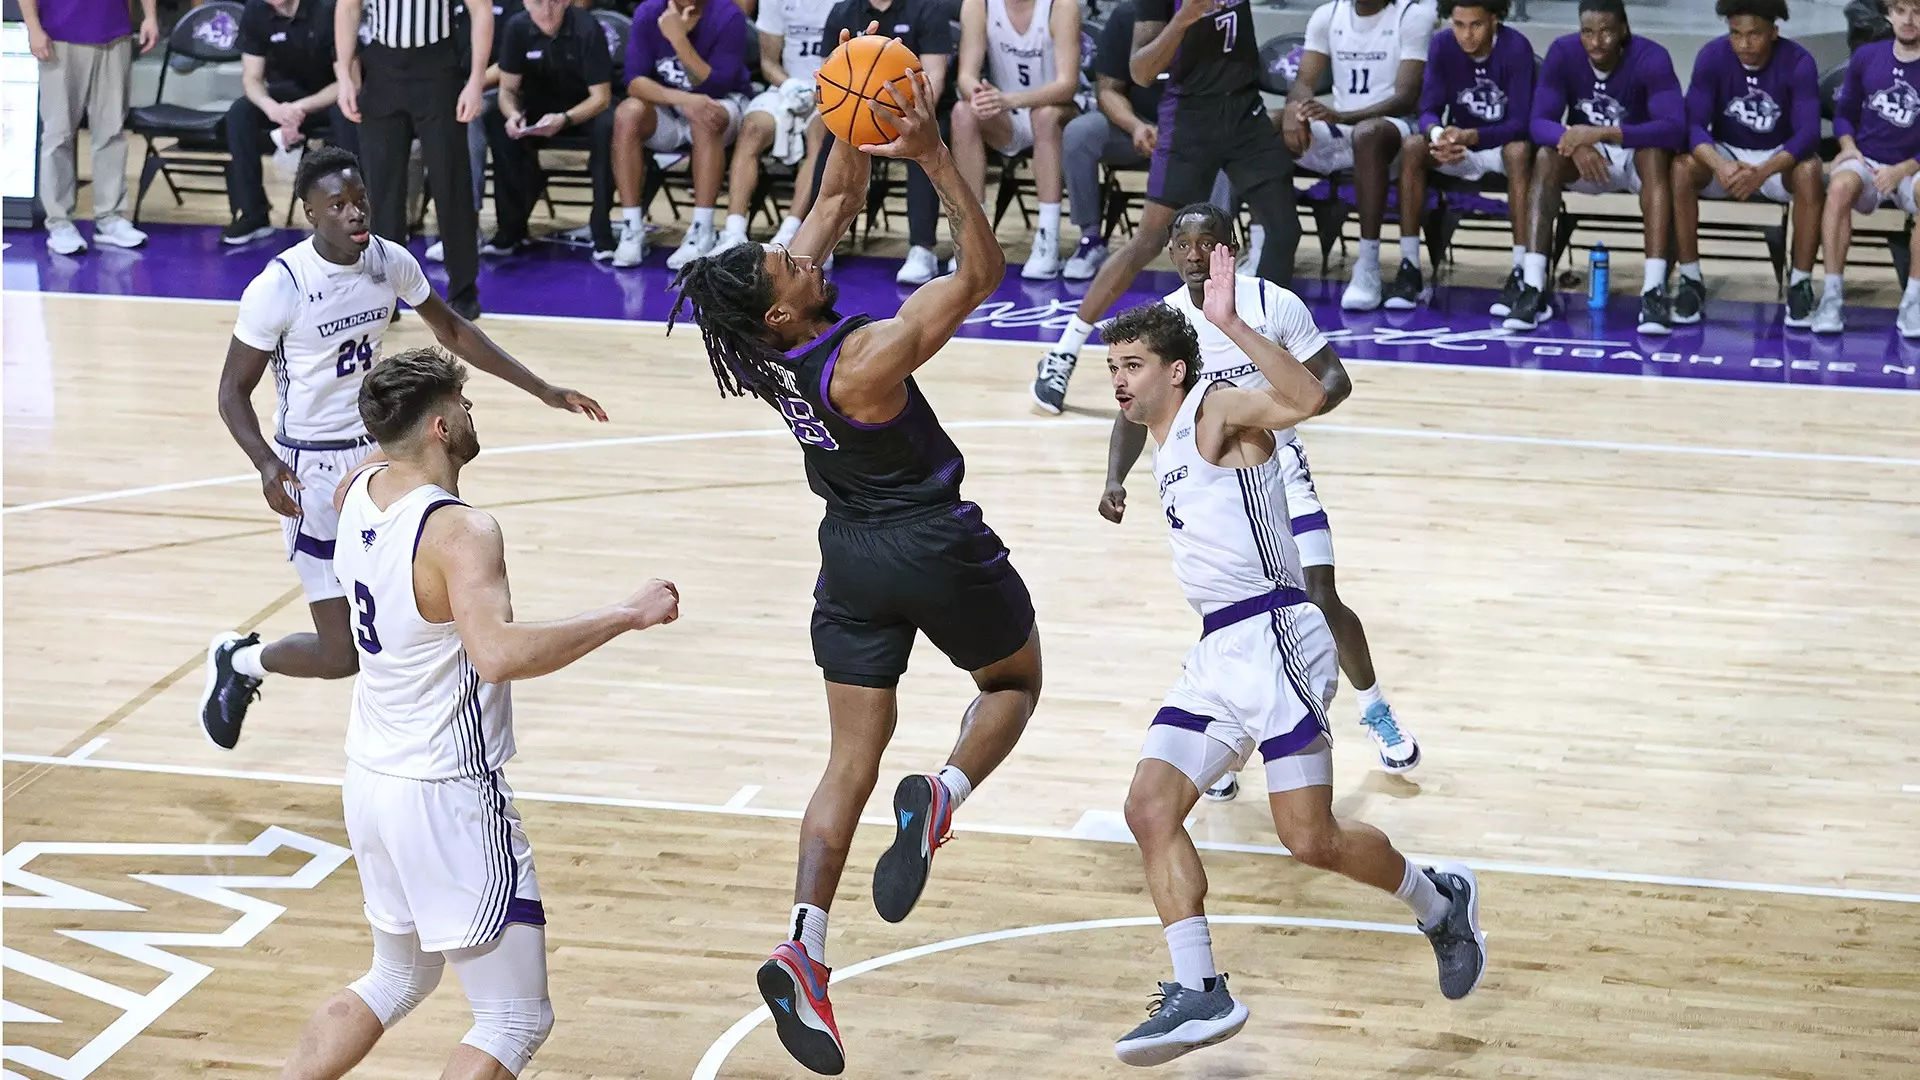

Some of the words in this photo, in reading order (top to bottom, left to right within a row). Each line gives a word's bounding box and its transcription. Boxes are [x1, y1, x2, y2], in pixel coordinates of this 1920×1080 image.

[1214, 10, 1238, 53] 7
[1017, 63, 1031, 87] 5
[1348, 68, 1370, 94] 11
[1460, 90, 1501, 119] ACU
[1728, 100, 1773, 130] ACU
[1871, 92, 1913, 125] ACU
[317, 306, 389, 338] WILDCATS
[336, 334, 373, 378] 24
[1533, 345, 1723, 366] COACH
[354, 579, 383, 655] 3
